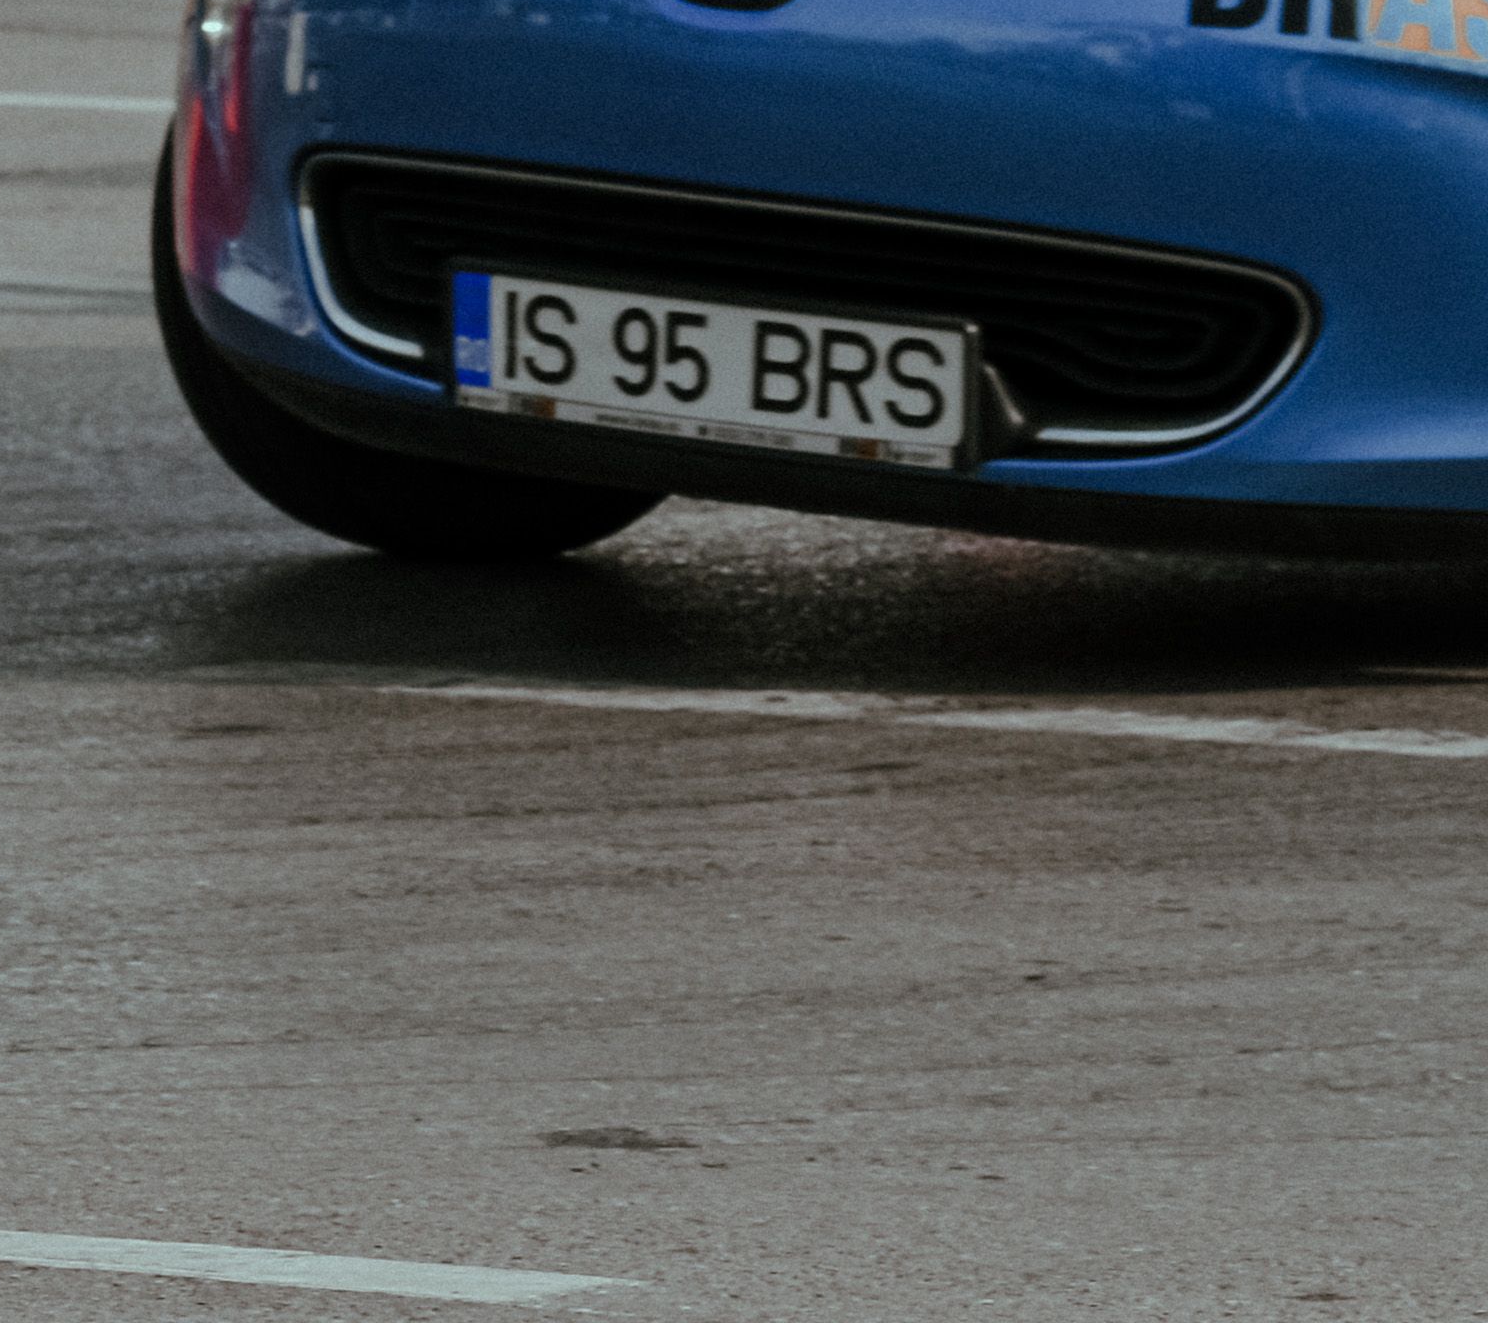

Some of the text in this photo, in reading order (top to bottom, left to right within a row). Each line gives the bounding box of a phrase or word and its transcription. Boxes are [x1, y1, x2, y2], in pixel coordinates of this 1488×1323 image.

[503, 289, 946, 430] IS 95 BRS
